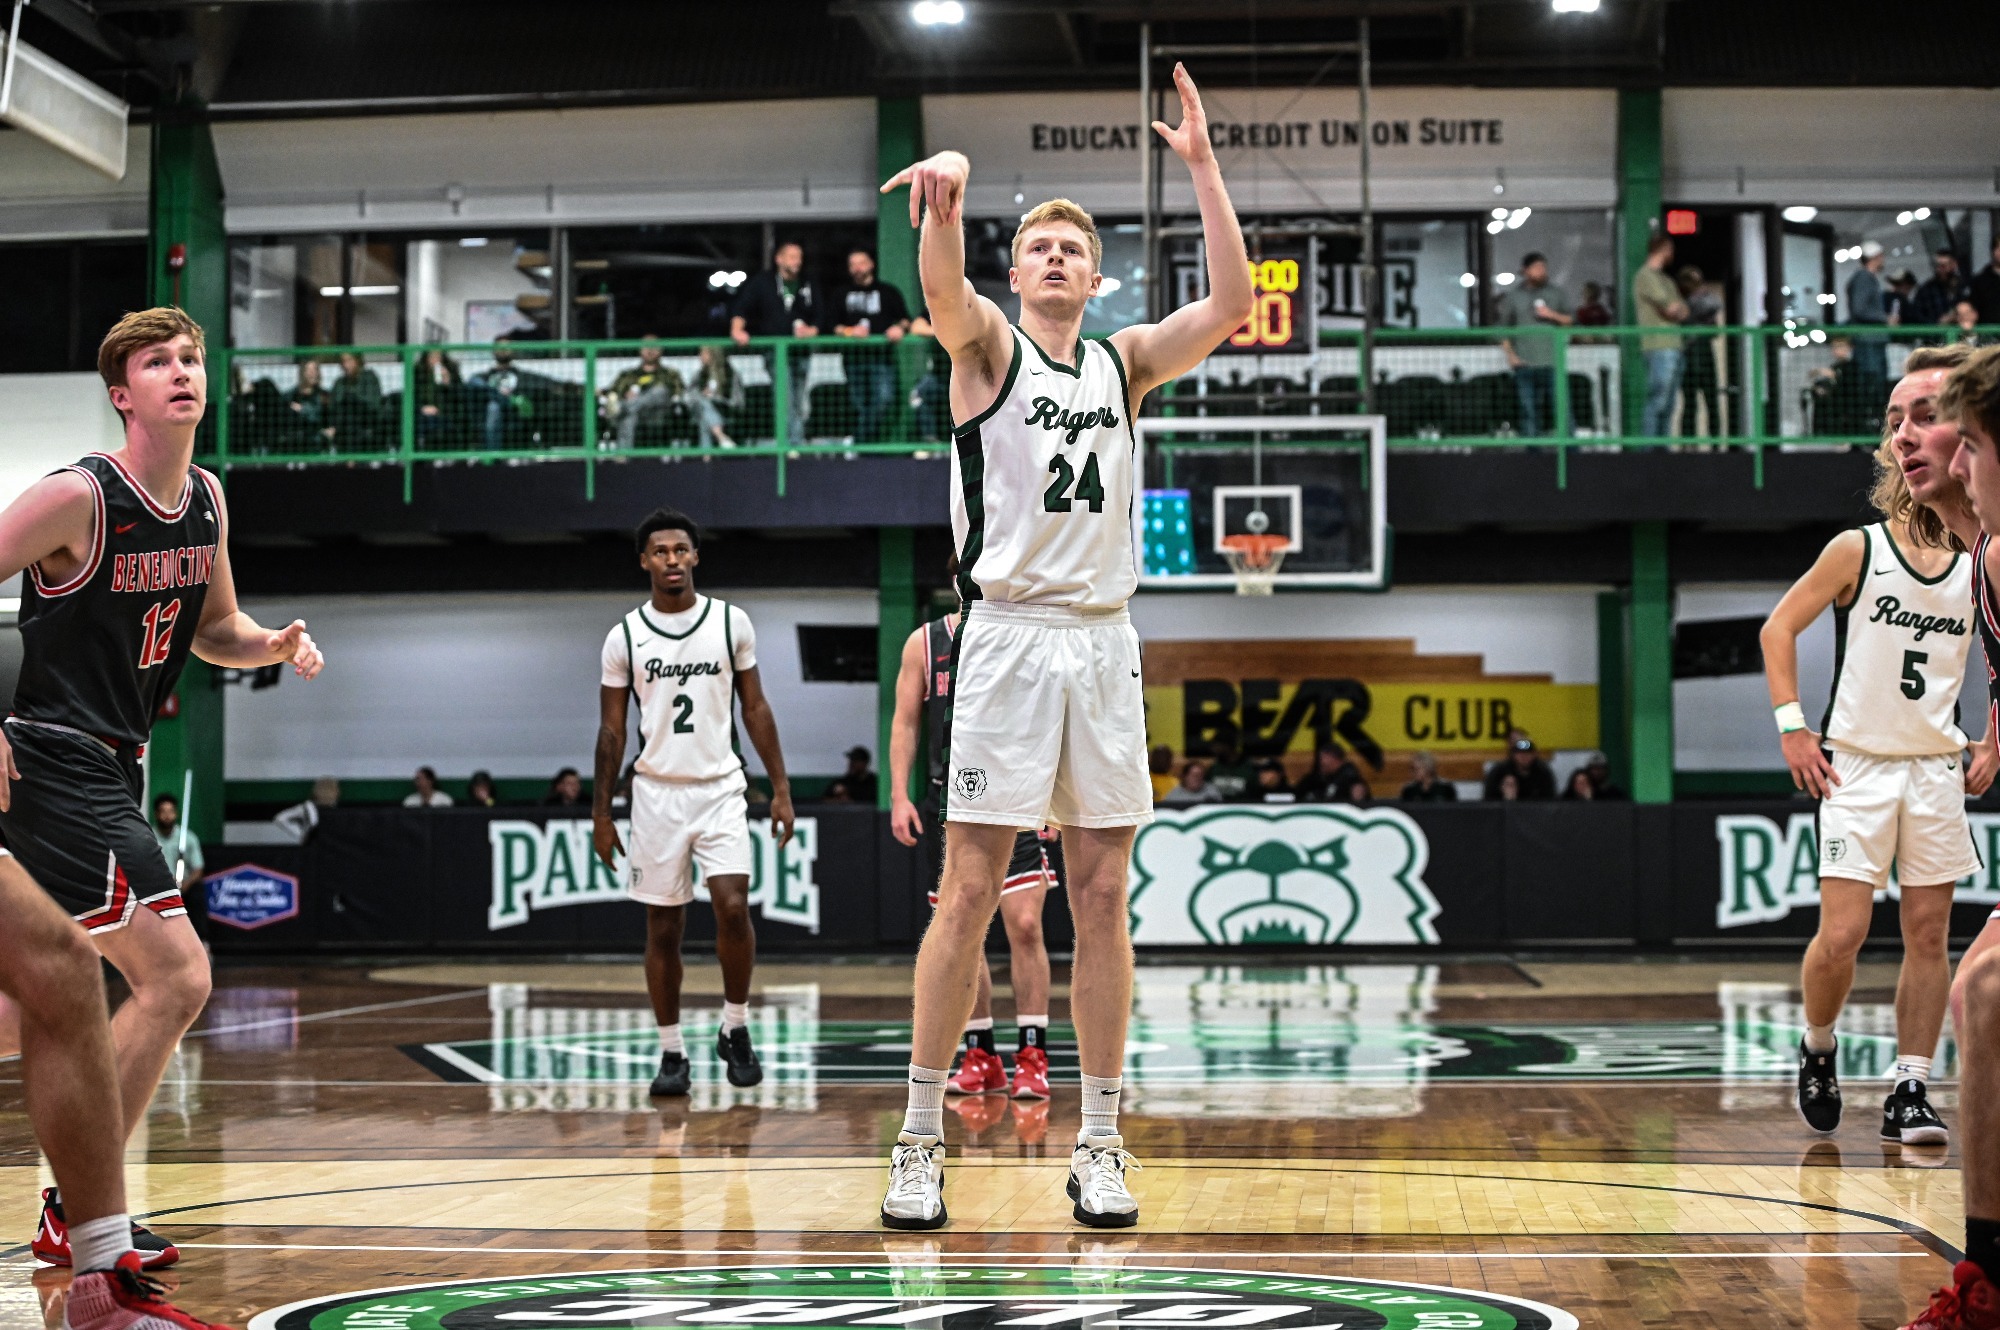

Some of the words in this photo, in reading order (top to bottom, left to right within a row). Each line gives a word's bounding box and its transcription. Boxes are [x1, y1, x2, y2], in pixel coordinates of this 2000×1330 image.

[1208, 121, 1312, 149] CREDIT
[1320, 119, 1410, 147] UNON
[1419, 116, 1503, 145] SUITE
[1043, 451, 1105, 513] 24
[111, 544, 217, 592] BENEDICTIN
[138, 598, 181, 669] 12
[1869, 594, 1967, 641] Rangers
[645, 657, 722, 686] Rangers
[1900, 649, 1929, 700] 5
[672, 693, 695, 734] 2
[1182, 678, 1385, 772] BEAR
[1404, 696, 1513, 741] CLUB
[443, 1270, 1029, 1300] CONFERENCE
[1057, 1273, 1441, 1305] ATHLETIC
[493, 1300, 1314, 1327] GLIAC
